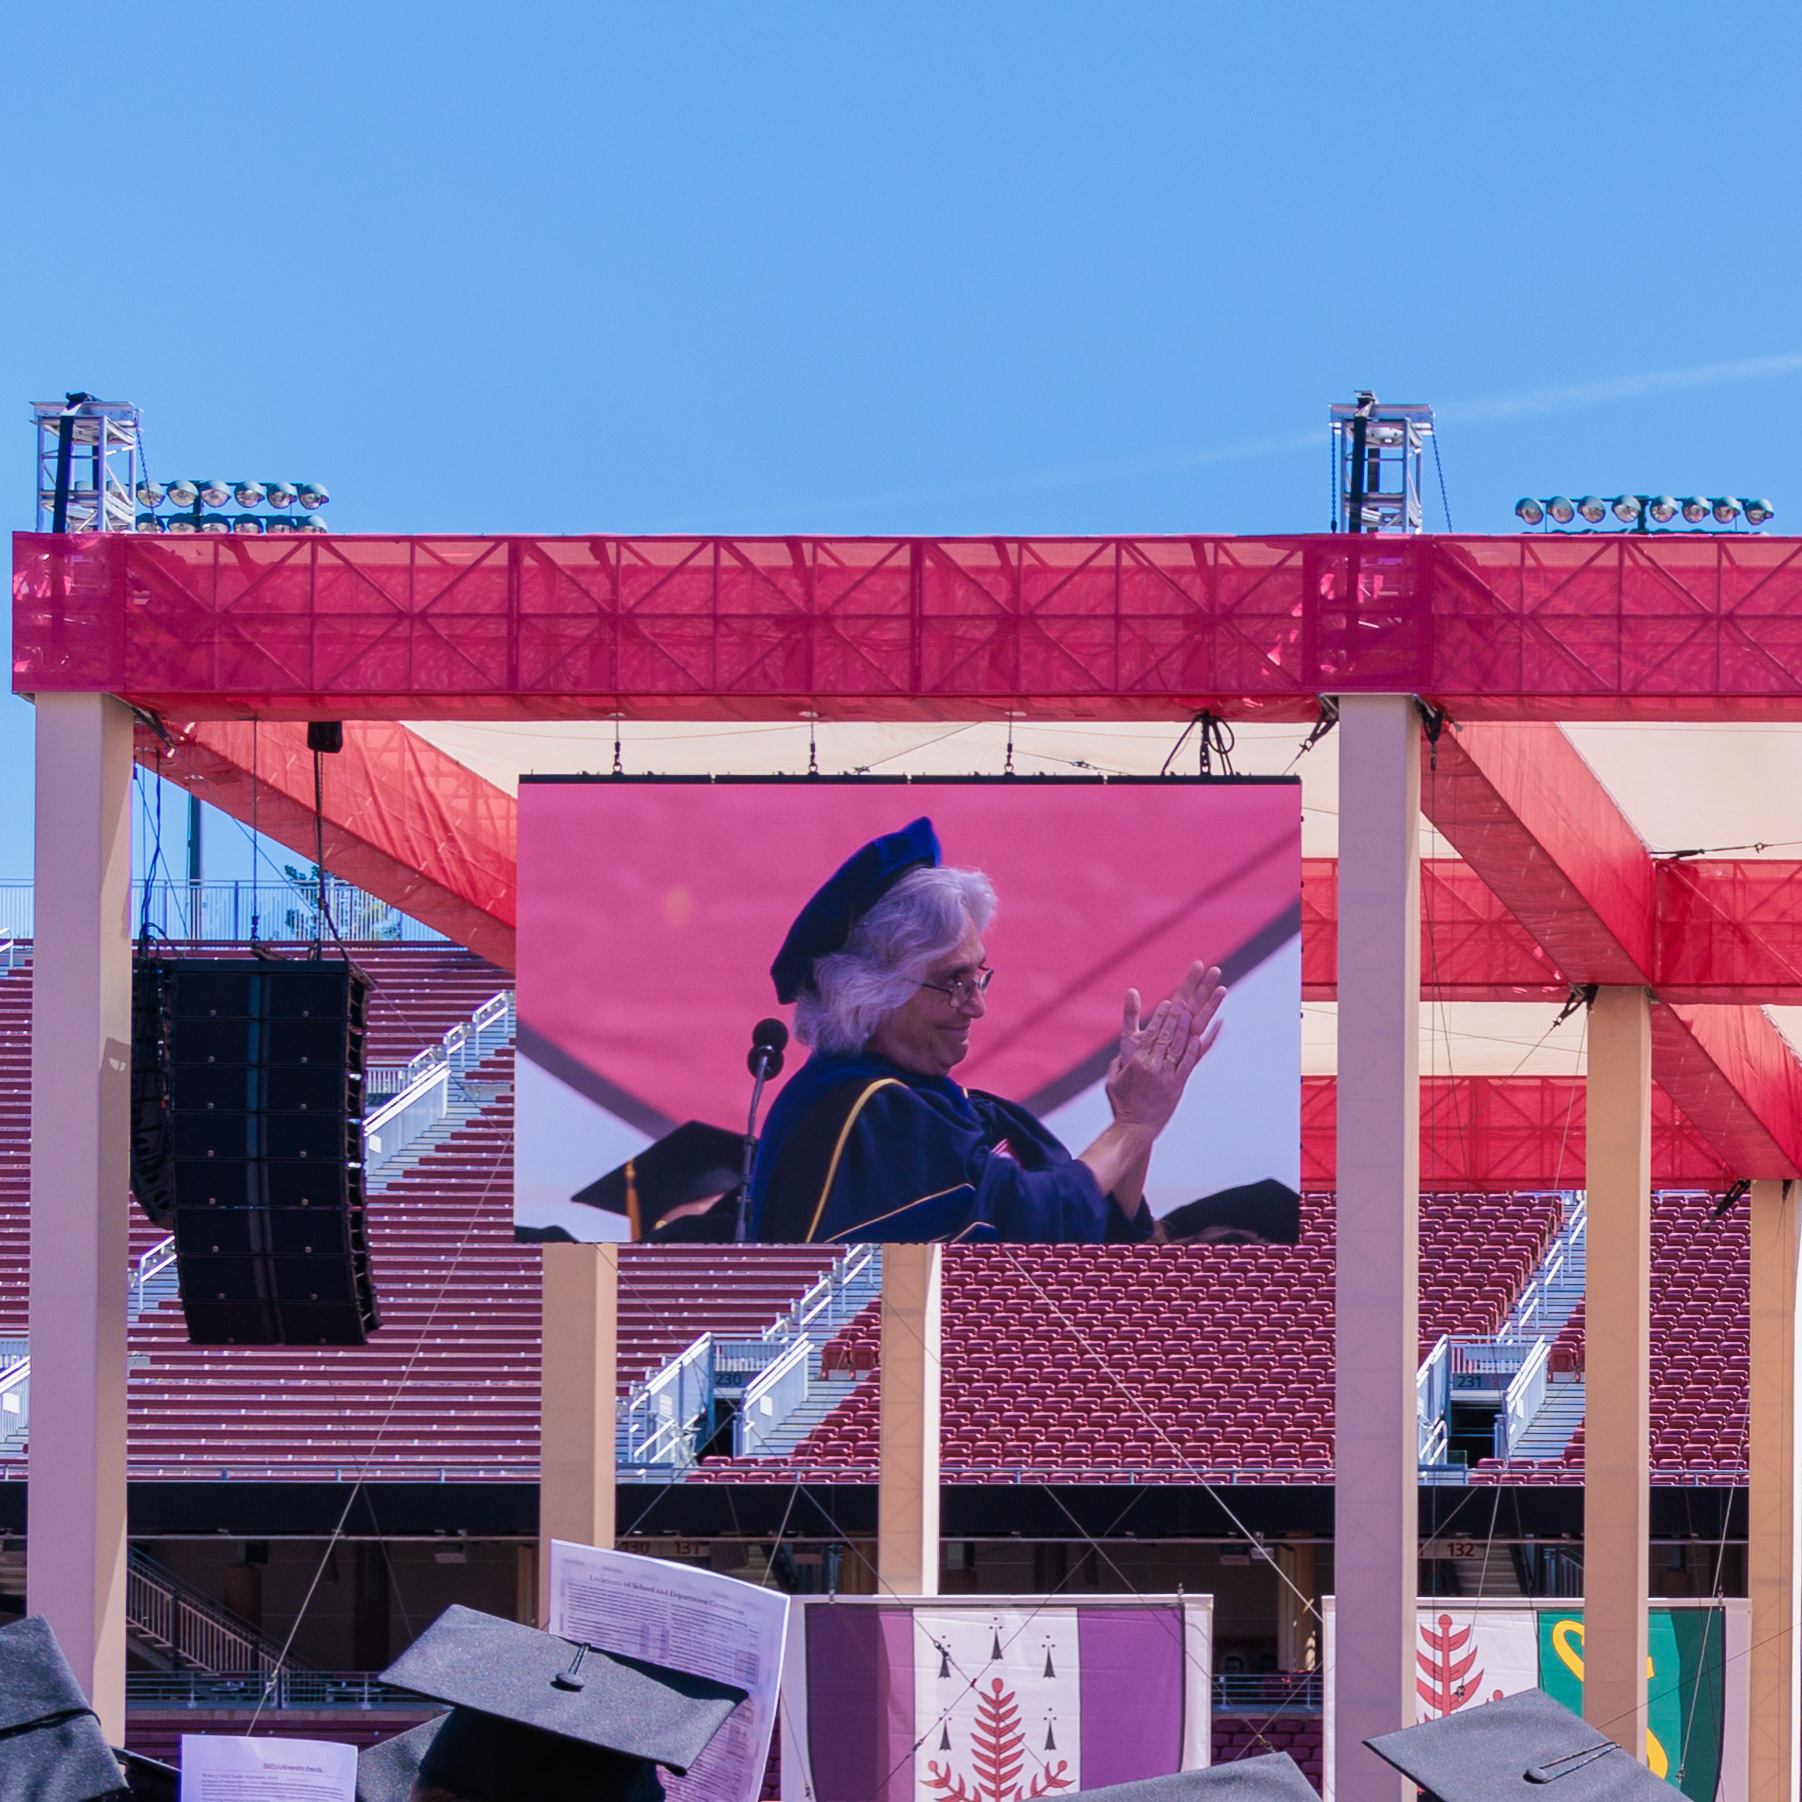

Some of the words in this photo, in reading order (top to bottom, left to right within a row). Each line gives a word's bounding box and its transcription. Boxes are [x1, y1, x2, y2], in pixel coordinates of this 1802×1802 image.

[715, 1373, 742, 1386] 230
[1457, 1375, 1482, 1388] 231
[673, 1541, 699, 1555] 131
[1447, 1542, 1475, 1557] 132
